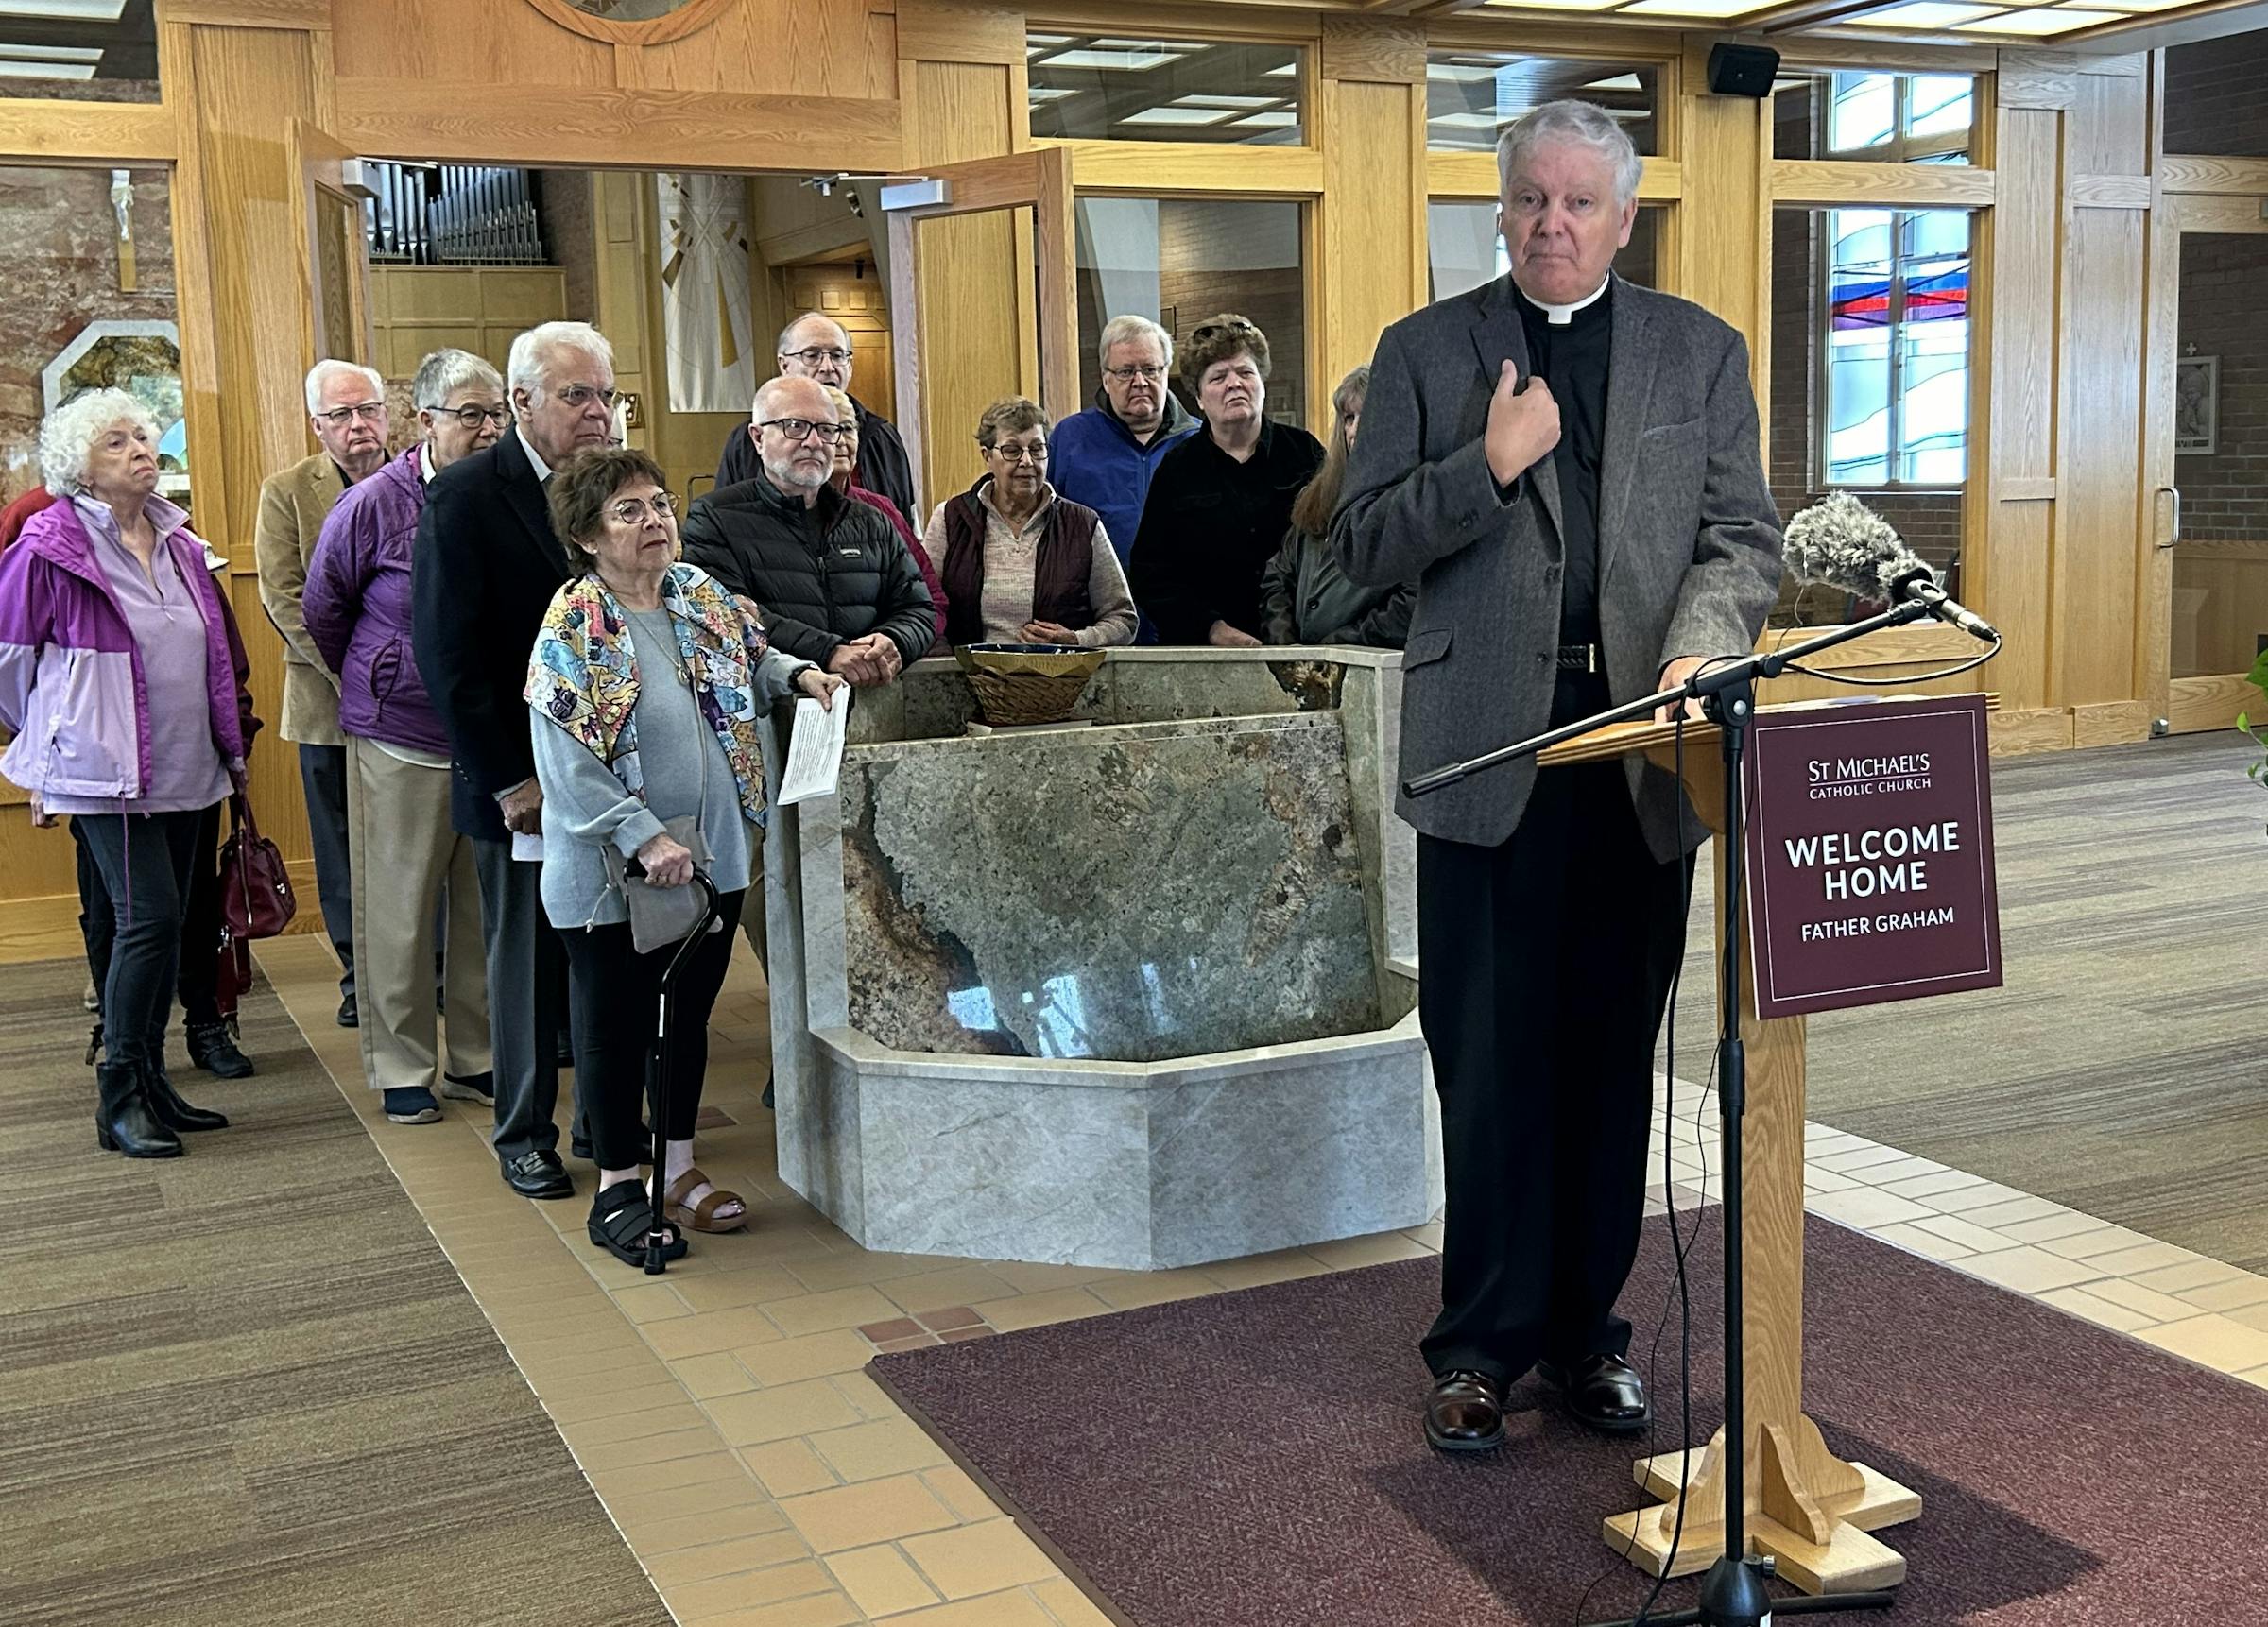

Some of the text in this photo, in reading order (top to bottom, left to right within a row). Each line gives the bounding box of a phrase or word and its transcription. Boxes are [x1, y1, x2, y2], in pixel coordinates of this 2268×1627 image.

[1809, 778, 1932, 800] CATHOLIC CHURCH
[1784, 821, 1960, 868] WELCOME
[1824, 861, 1928, 900] HOME
[1801, 906, 1954, 942] FATHER GRAHAM
